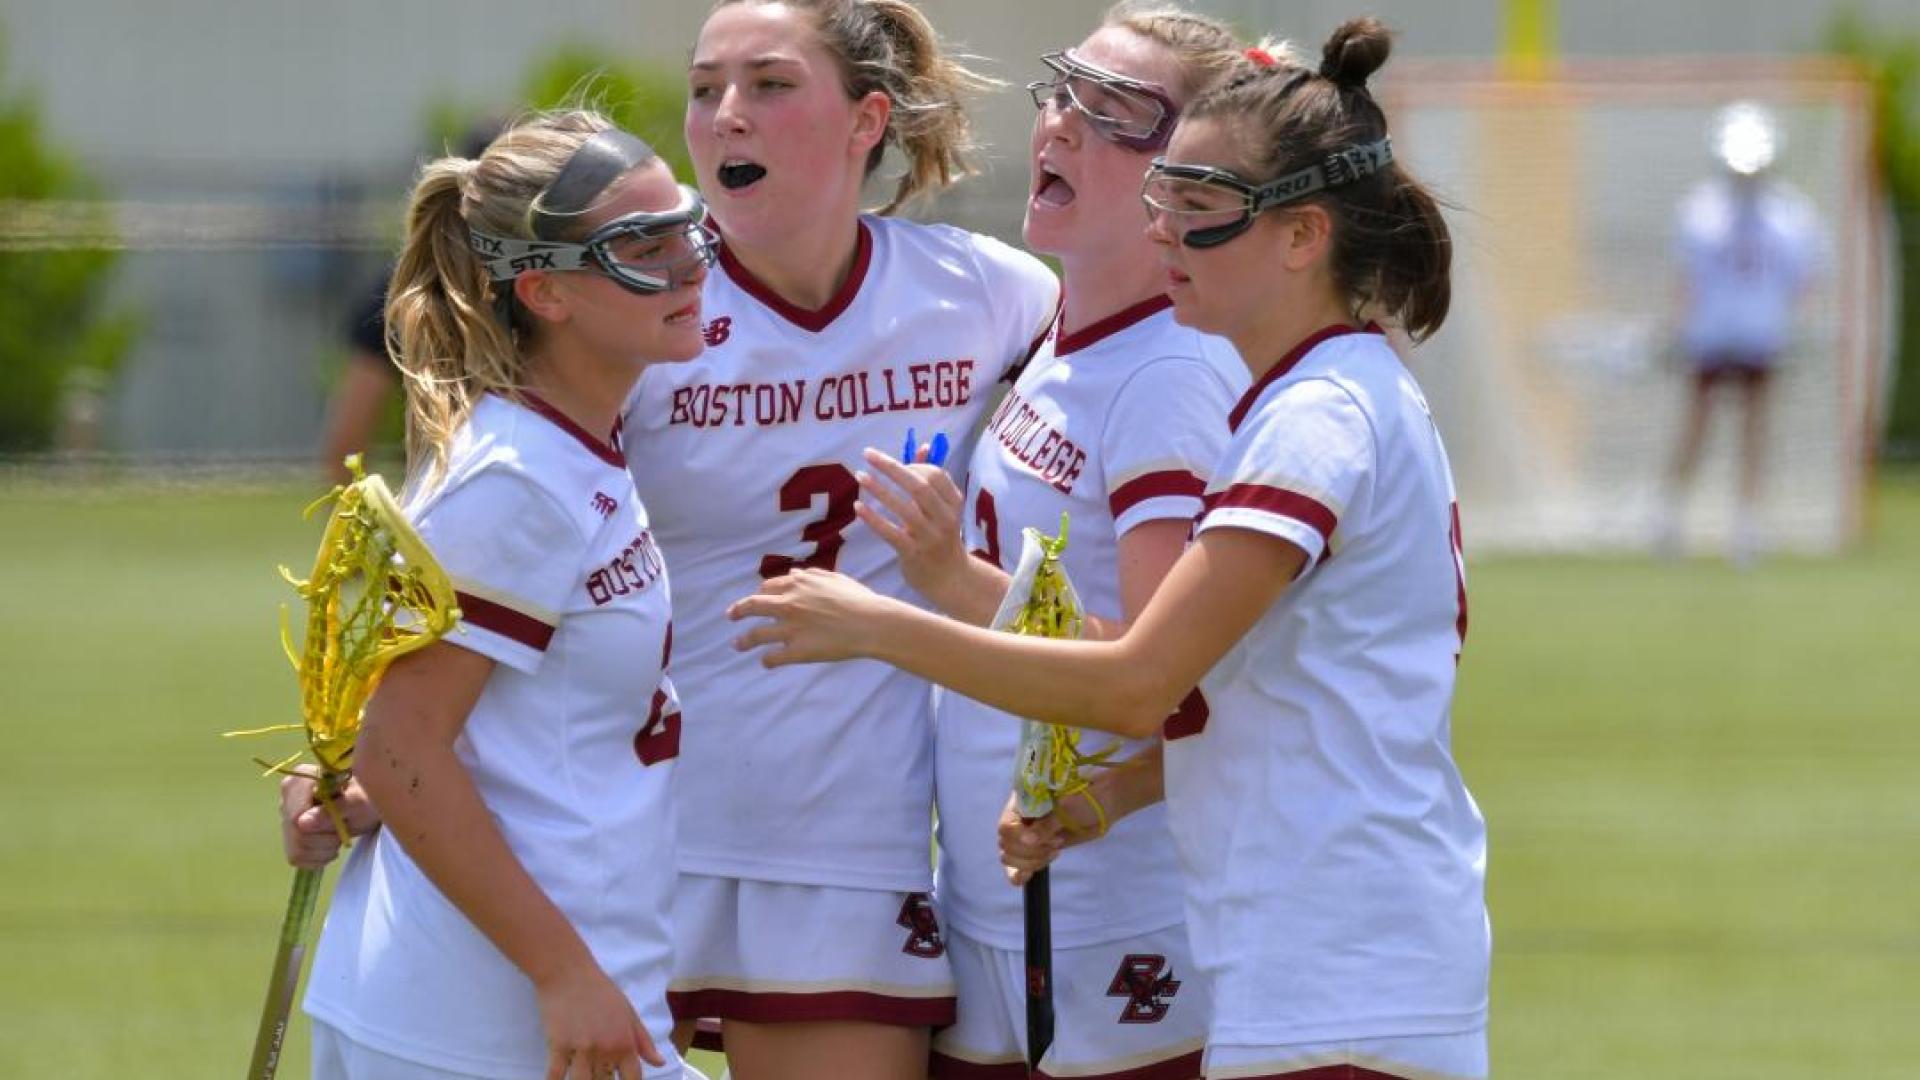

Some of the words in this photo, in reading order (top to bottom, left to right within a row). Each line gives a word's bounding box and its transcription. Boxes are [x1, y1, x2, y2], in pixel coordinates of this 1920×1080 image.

[509, 251, 556, 275] STX
[669, 379, 806, 428] BOSTON
[815, 360, 974, 420] COLLEGE
[998, 402, 1087, 495] COLLEGE
[759, 463, 860, 580] 3
